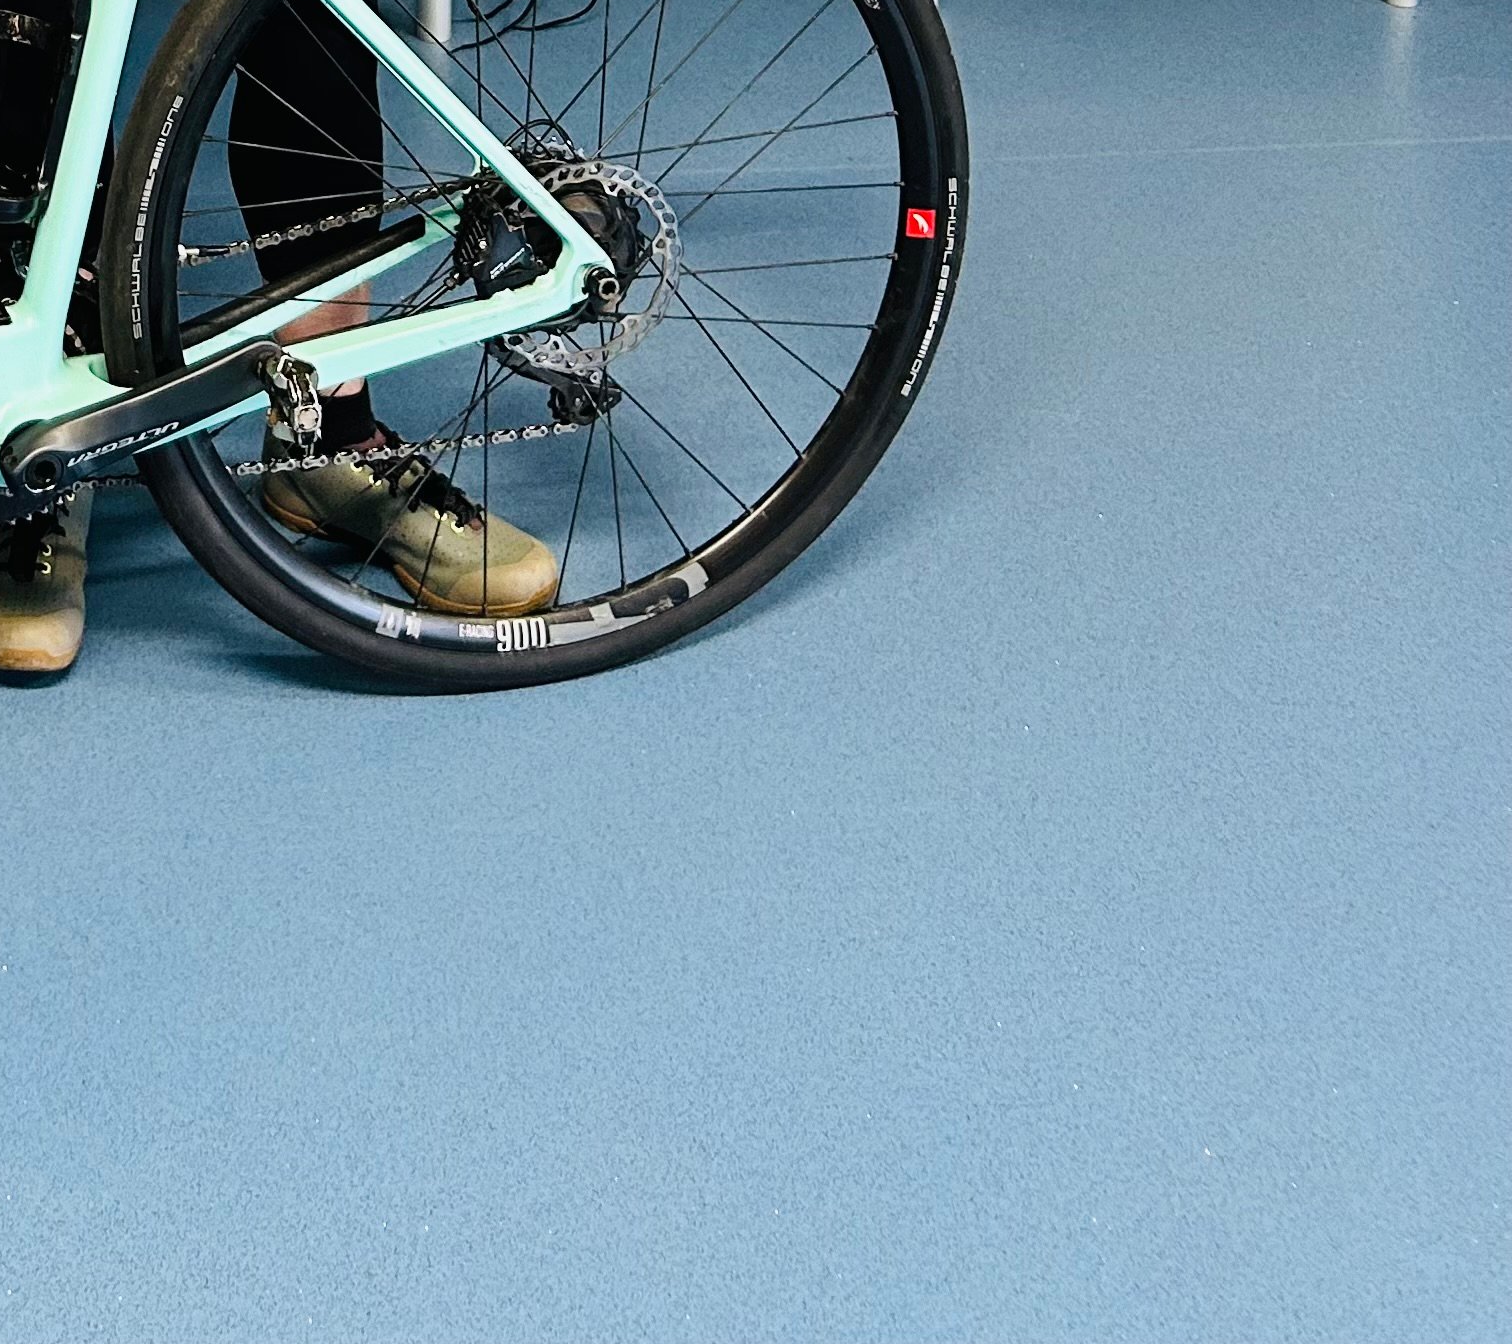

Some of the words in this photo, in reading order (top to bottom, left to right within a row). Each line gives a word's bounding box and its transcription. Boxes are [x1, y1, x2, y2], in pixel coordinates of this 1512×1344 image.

[131, 212, 147, 340] SCHWALBE
[160, 95, 184, 137] ONE
[938, 177, 958, 291] SCHWALBE
[67, 421, 180, 467] ULTEGRA
